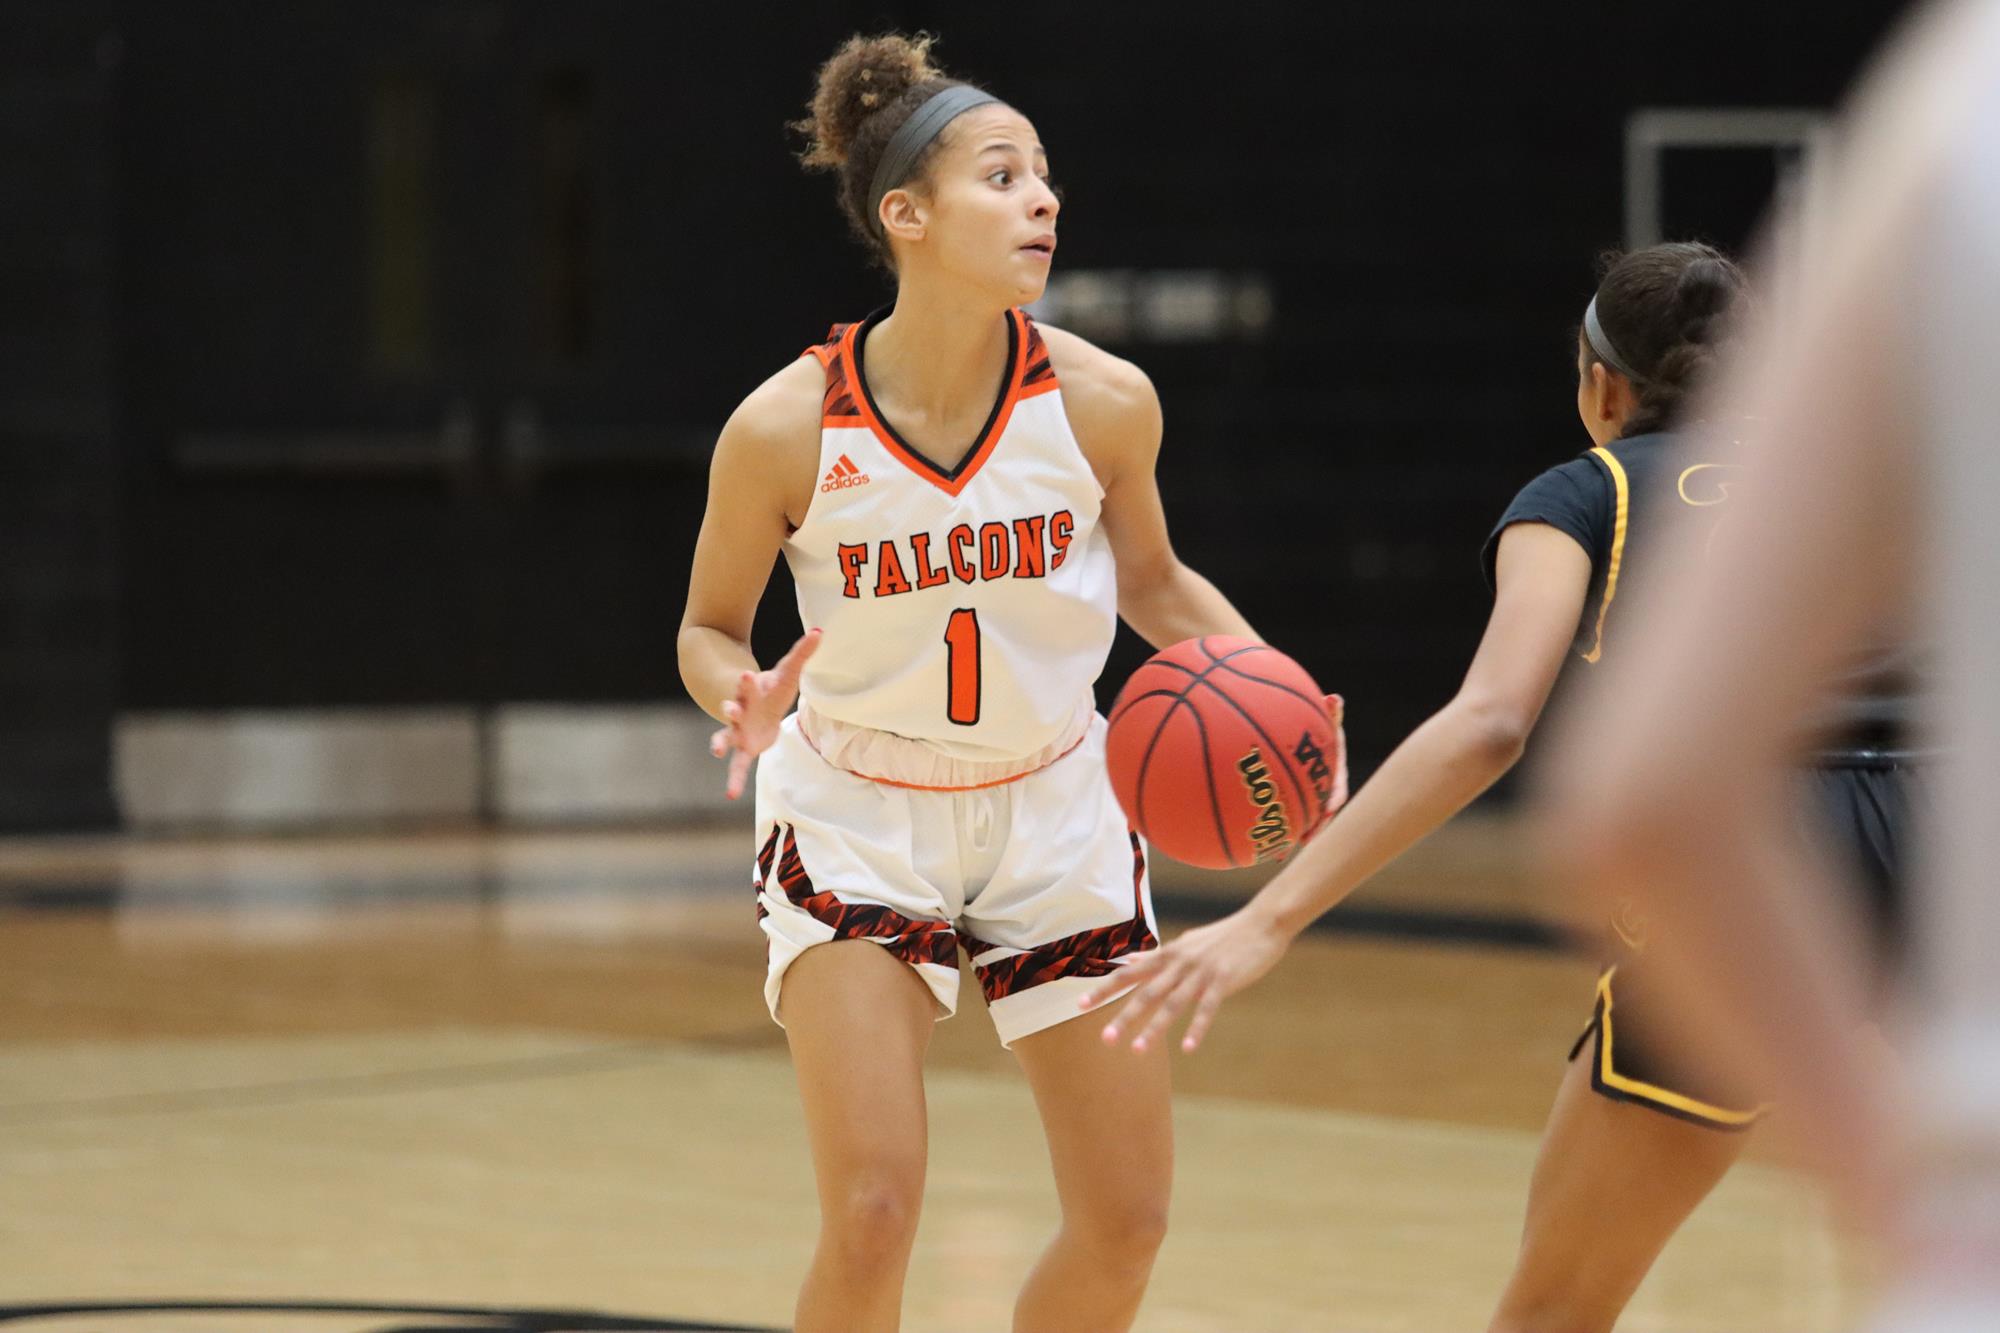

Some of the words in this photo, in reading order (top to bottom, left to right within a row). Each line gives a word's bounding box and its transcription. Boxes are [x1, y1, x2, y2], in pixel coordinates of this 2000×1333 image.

[820, 472, 870, 493] adidas
[837, 509, 1074, 599] FALCONS
[944, 607, 981, 726] 1
[1293, 731, 1329, 814] AA
